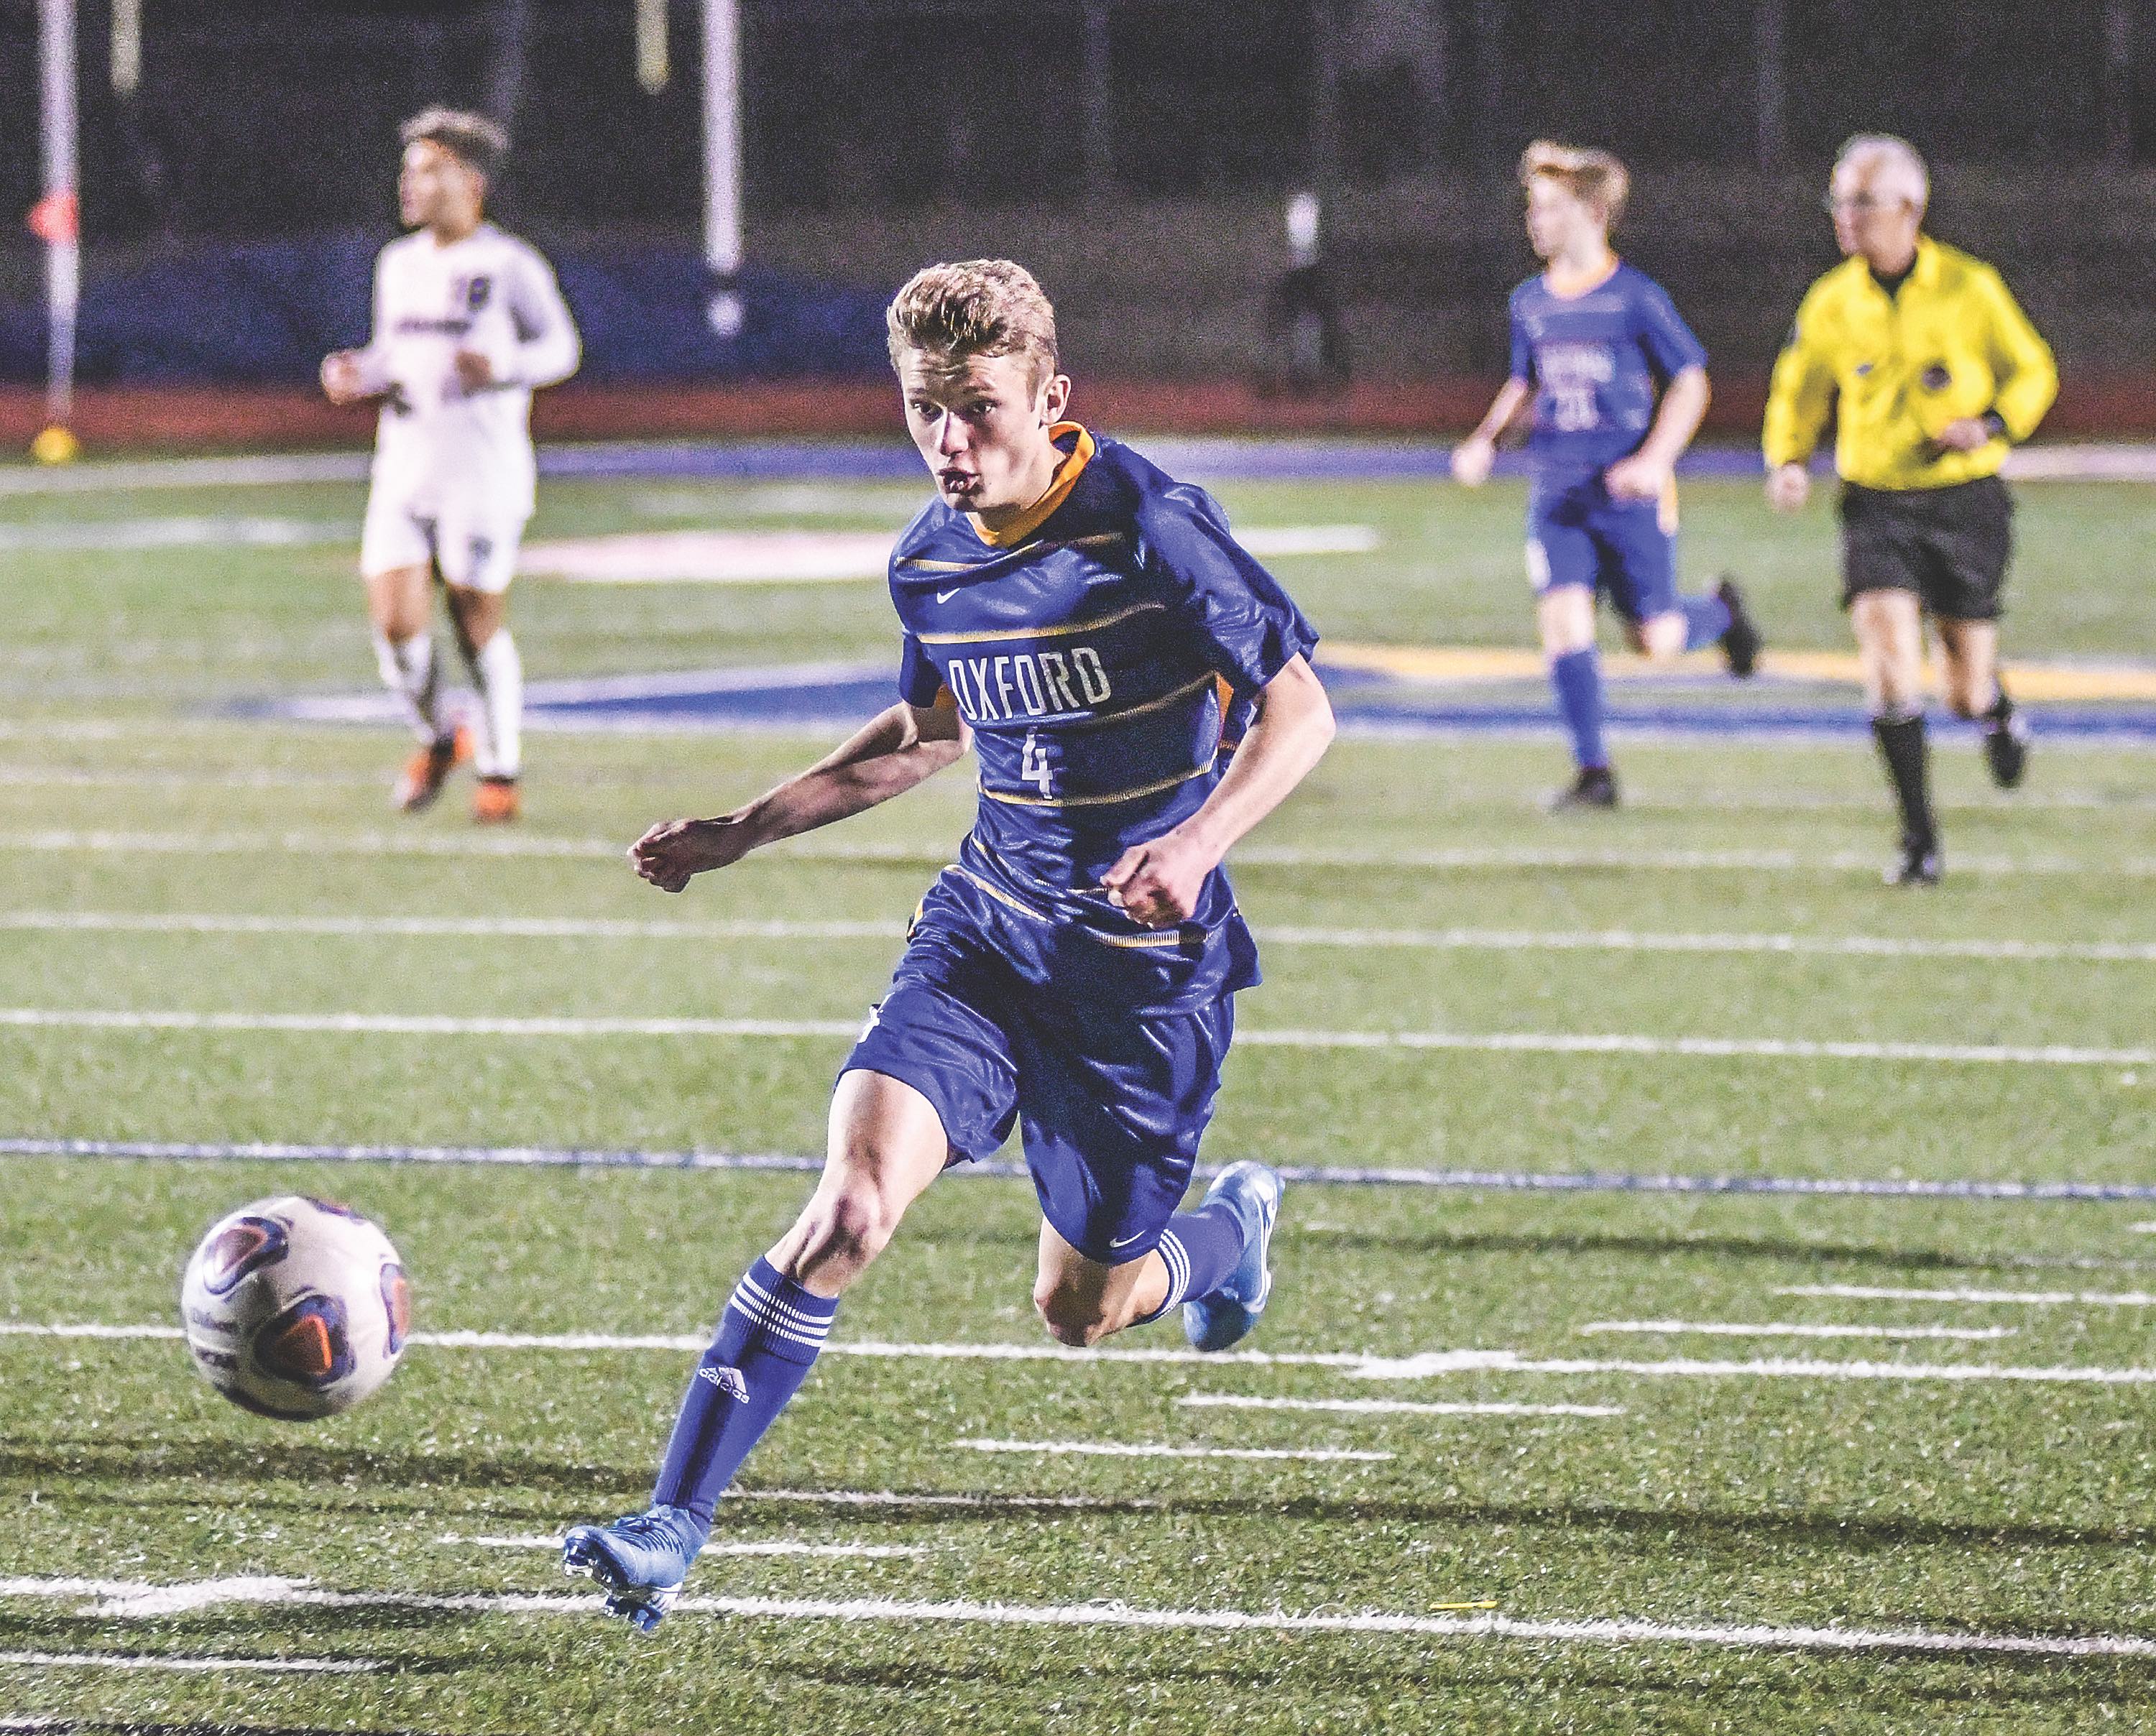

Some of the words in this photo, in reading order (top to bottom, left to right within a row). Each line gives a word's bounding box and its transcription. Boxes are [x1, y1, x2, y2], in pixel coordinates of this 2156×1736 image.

[949, 647, 1111, 720] OXFORD
[1022, 726, 1053, 799] 4
[699, 1368, 750, 1403] adidas
